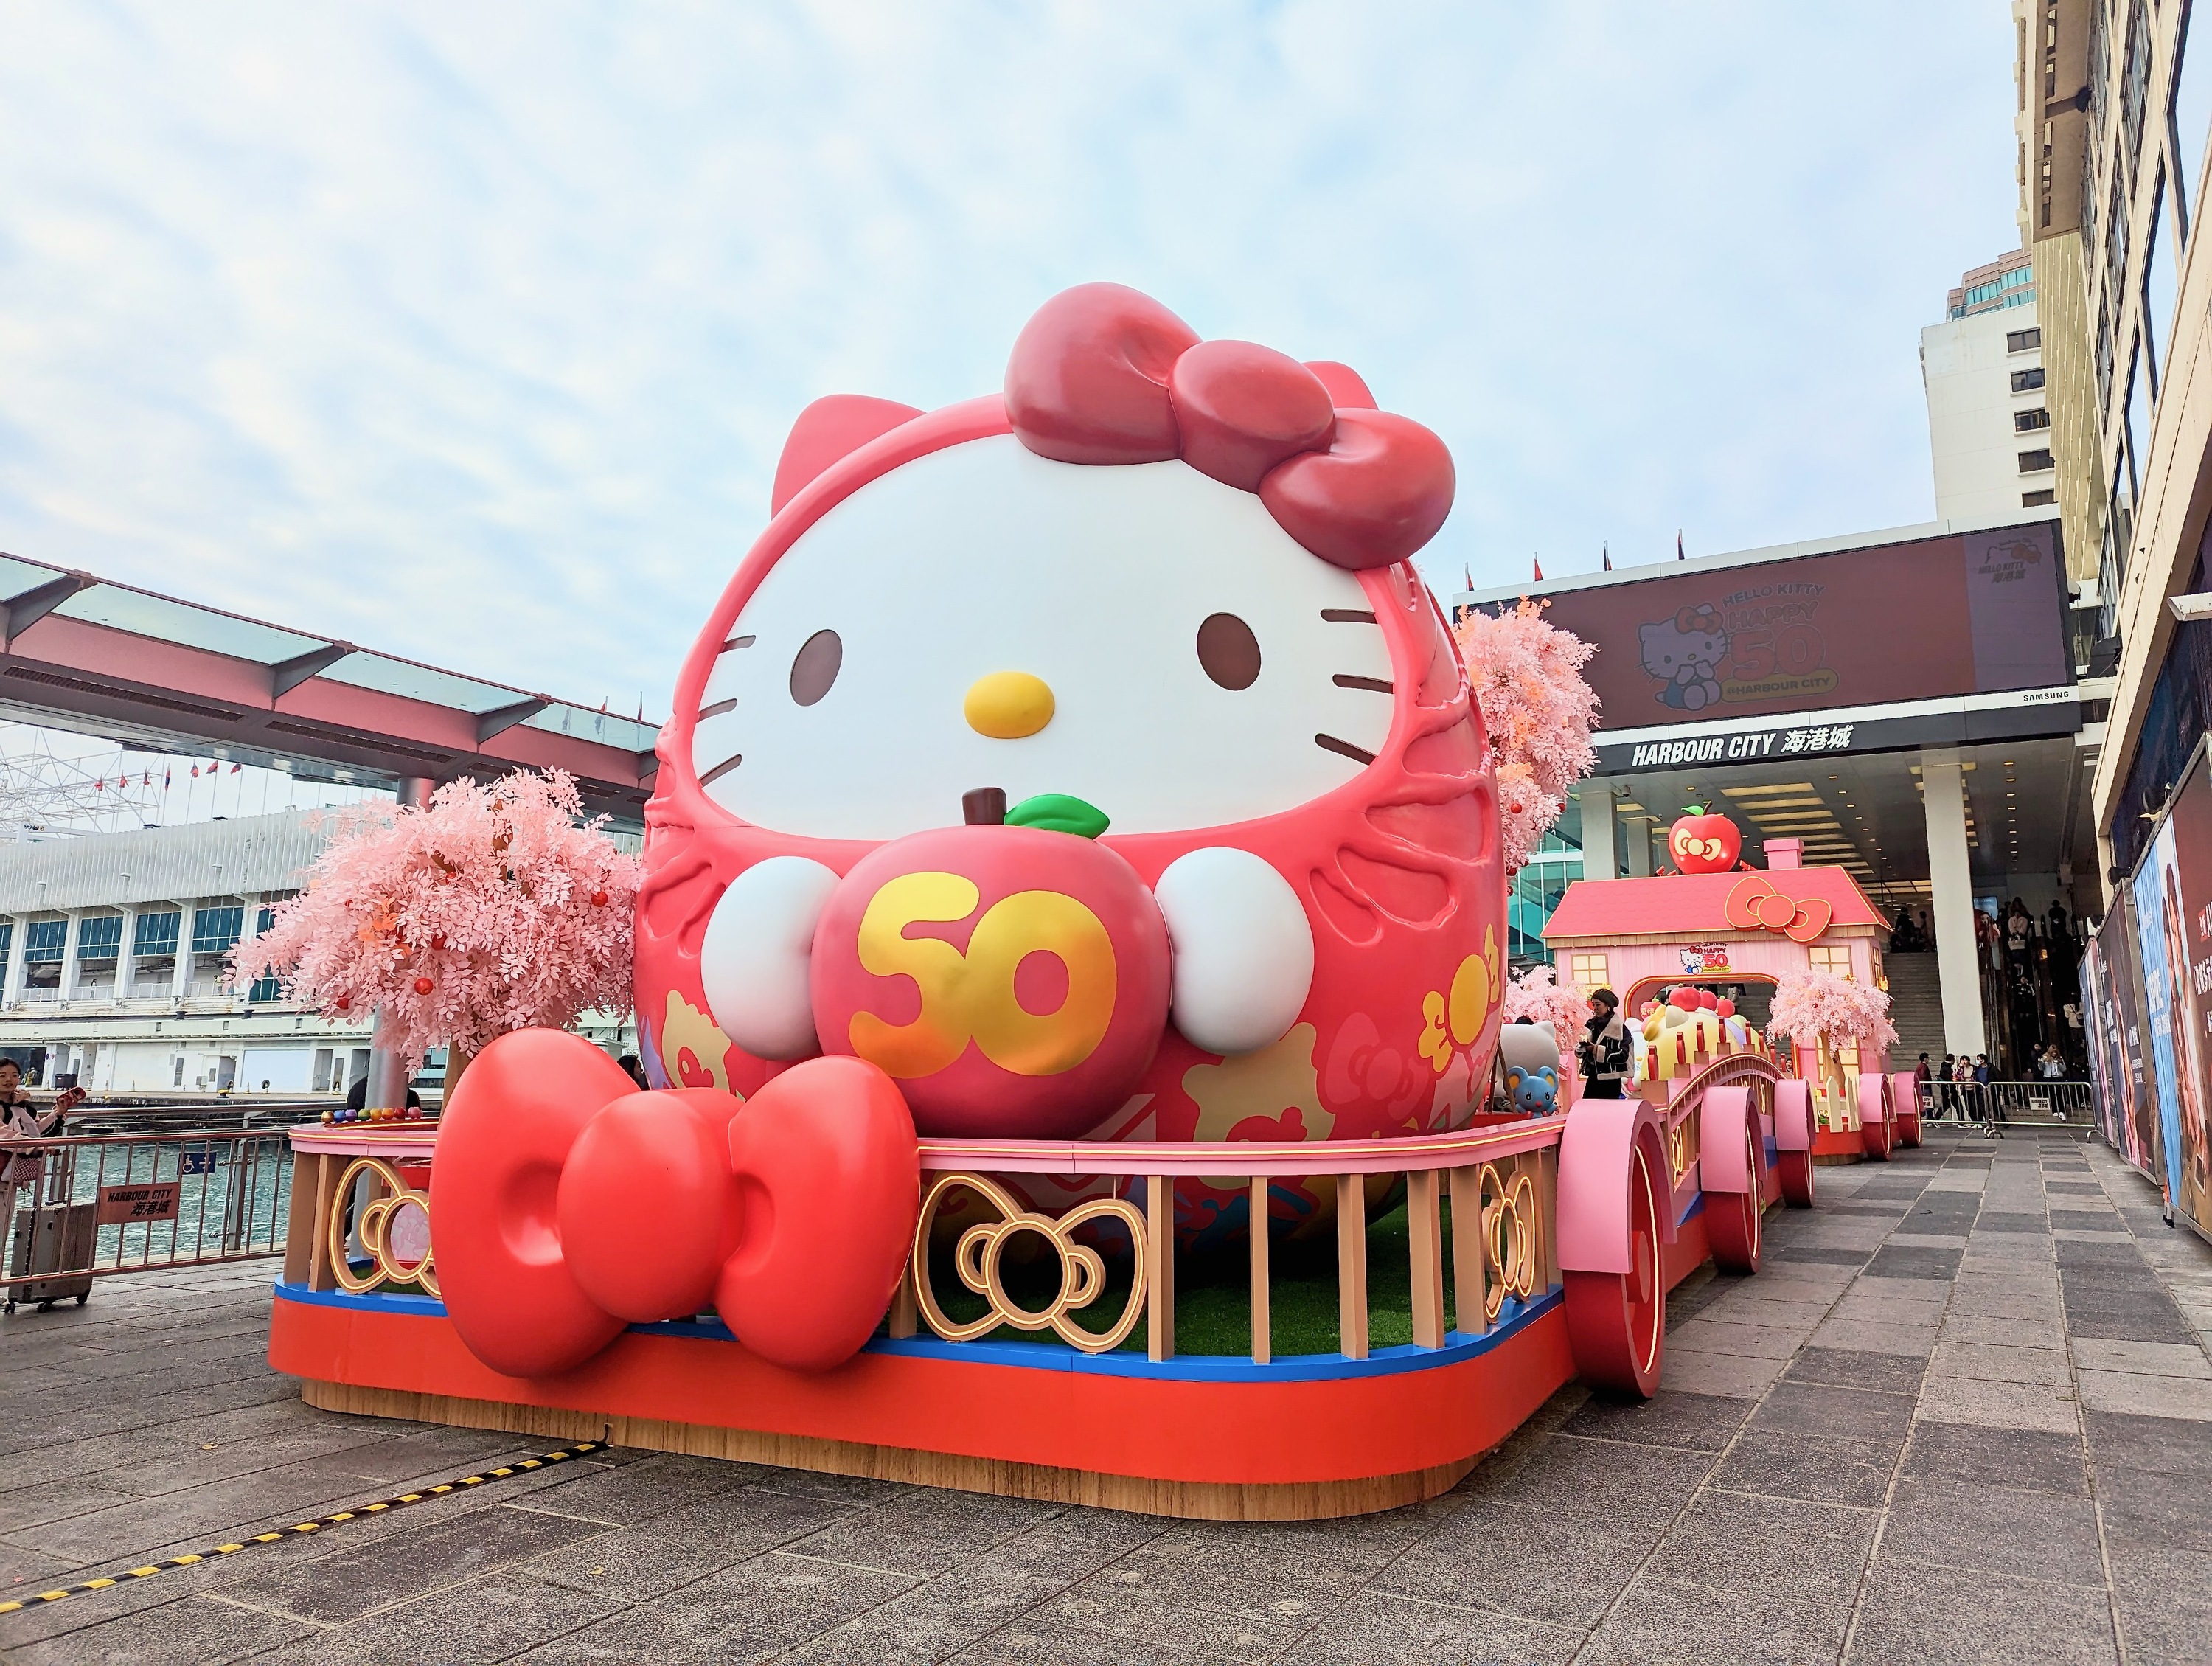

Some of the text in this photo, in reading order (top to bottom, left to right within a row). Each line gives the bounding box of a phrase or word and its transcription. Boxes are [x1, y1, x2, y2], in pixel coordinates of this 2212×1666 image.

[1978, 561, 2025, 574] HELLO KITTY
[1722, 583, 1825, 608] HELLO KITTY
[1728, 600, 1820, 630] HAPPY
[1731, 625, 1826, 681] 50
[1728, 677, 1831, 695] @HARBOUR CITY
[2023, 691, 2069, 701] SAMSUNG
[1631, 725, 1854, 766] HARBOUR CITY 海港城
[1704, 954, 1728, 968] 50
[849, 871, 1117, 1079] 50
[107, 1188, 173, 1203] HARBOUR CITY
[130, 1199, 172, 1216] 海港城
